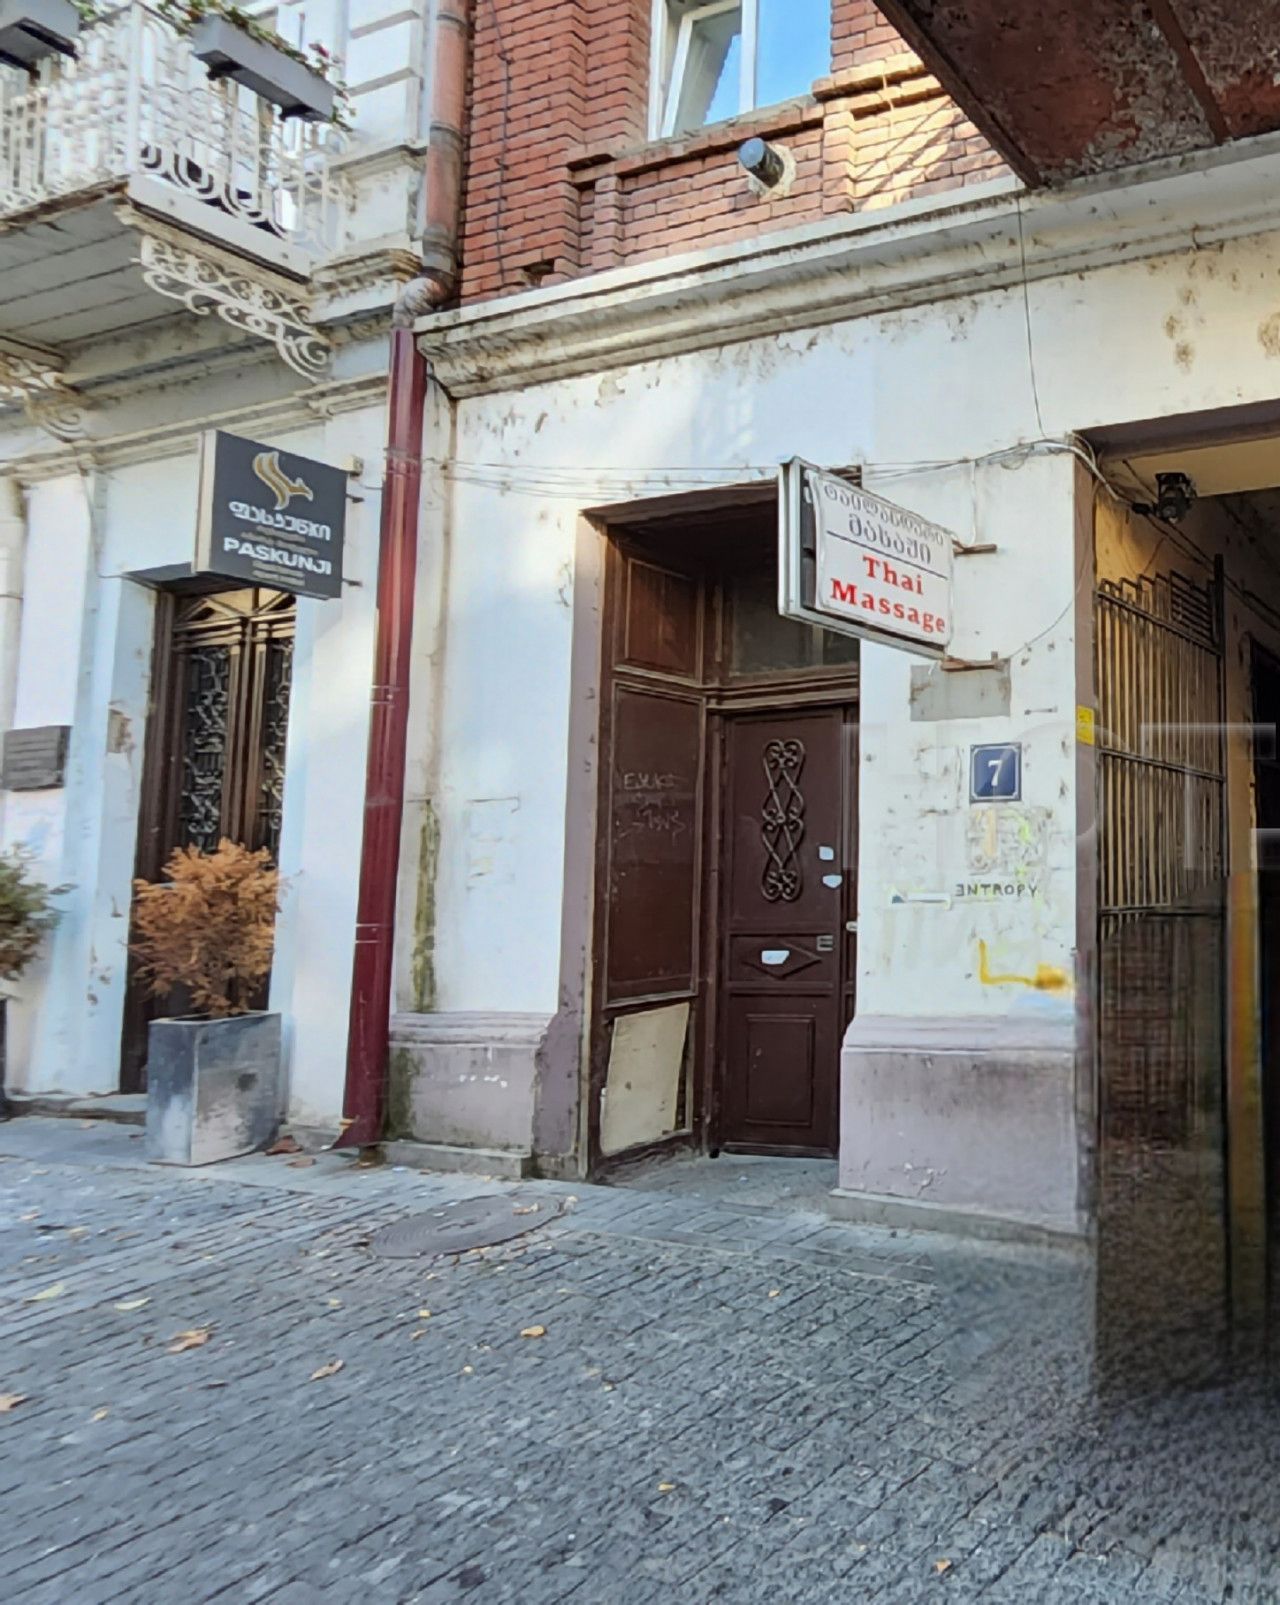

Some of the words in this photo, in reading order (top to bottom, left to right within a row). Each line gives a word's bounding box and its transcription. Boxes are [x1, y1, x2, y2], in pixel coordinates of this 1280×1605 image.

[223, 537, 332, 575] PASKUNJI
[863, 555, 924, 596] Thai
[830, 578, 945, 633] Massage
[988, 759, 1003, 787] 7
